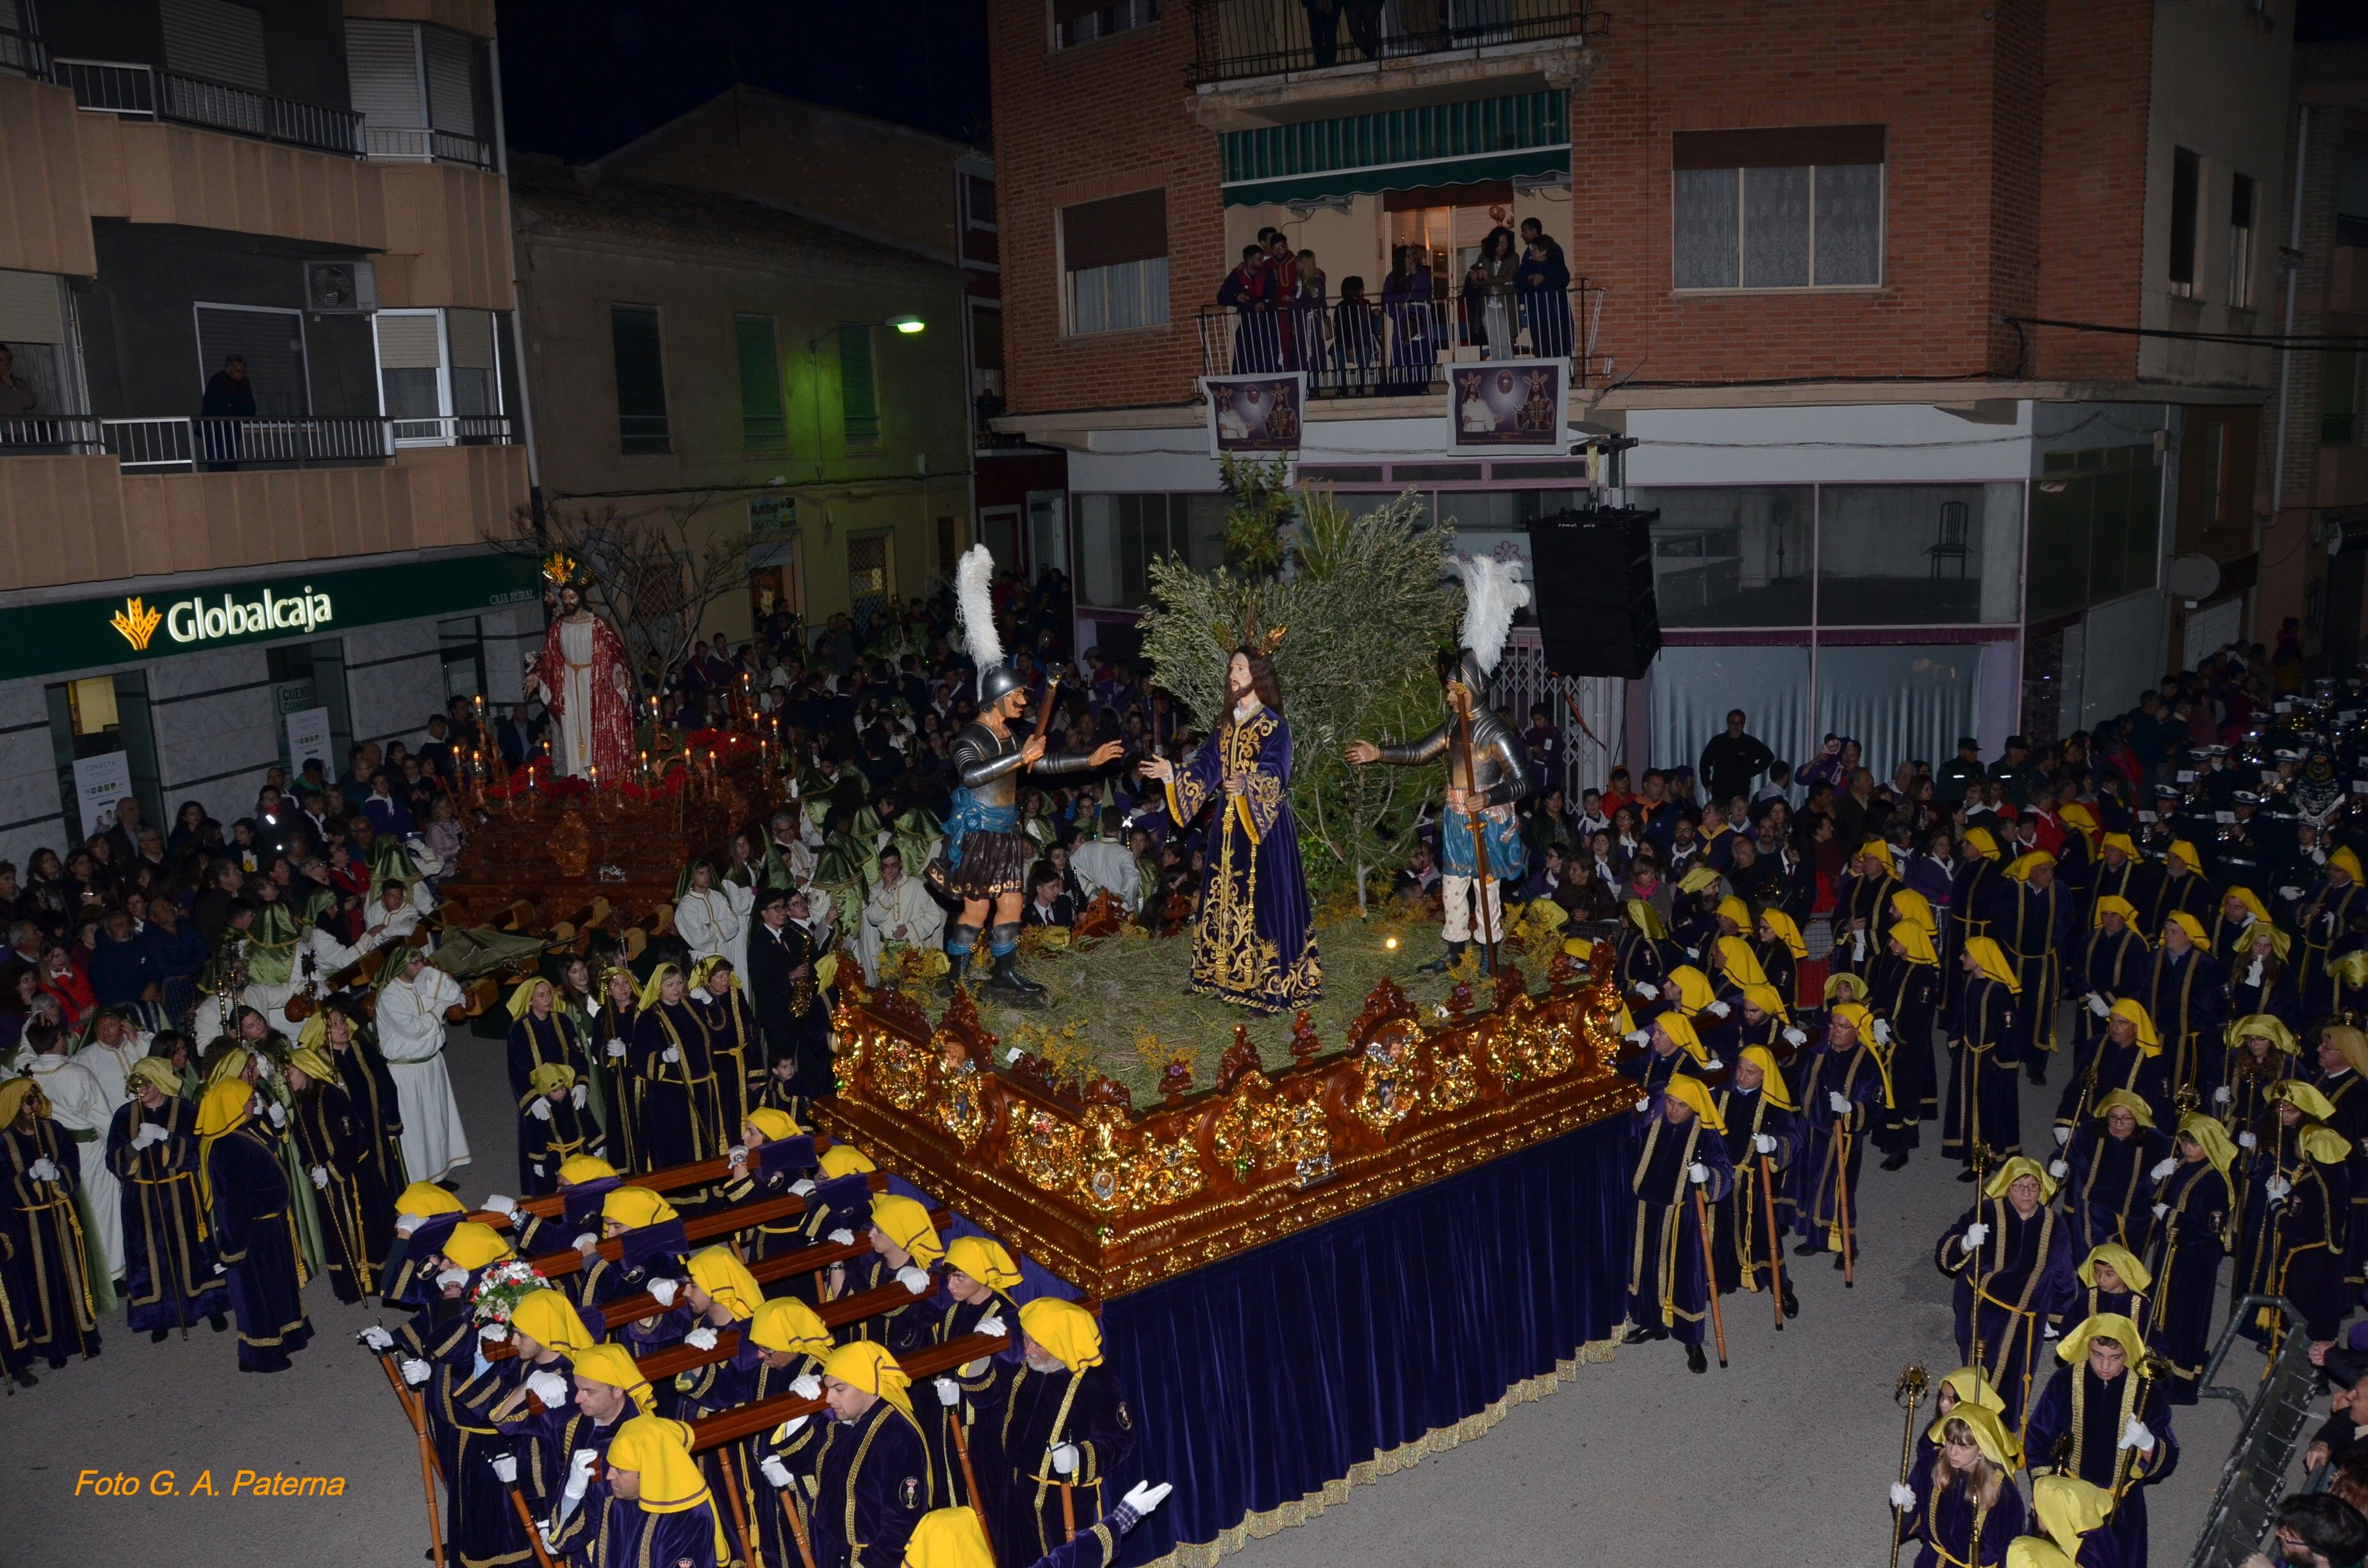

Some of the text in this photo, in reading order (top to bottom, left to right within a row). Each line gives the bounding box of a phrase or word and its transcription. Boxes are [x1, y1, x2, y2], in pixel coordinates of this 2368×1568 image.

[489, 589, 536, 605] CAJA RURAL
[167, 585, 333, 642] Globalcaja
[85, 760, 116, 772] CONECTA
